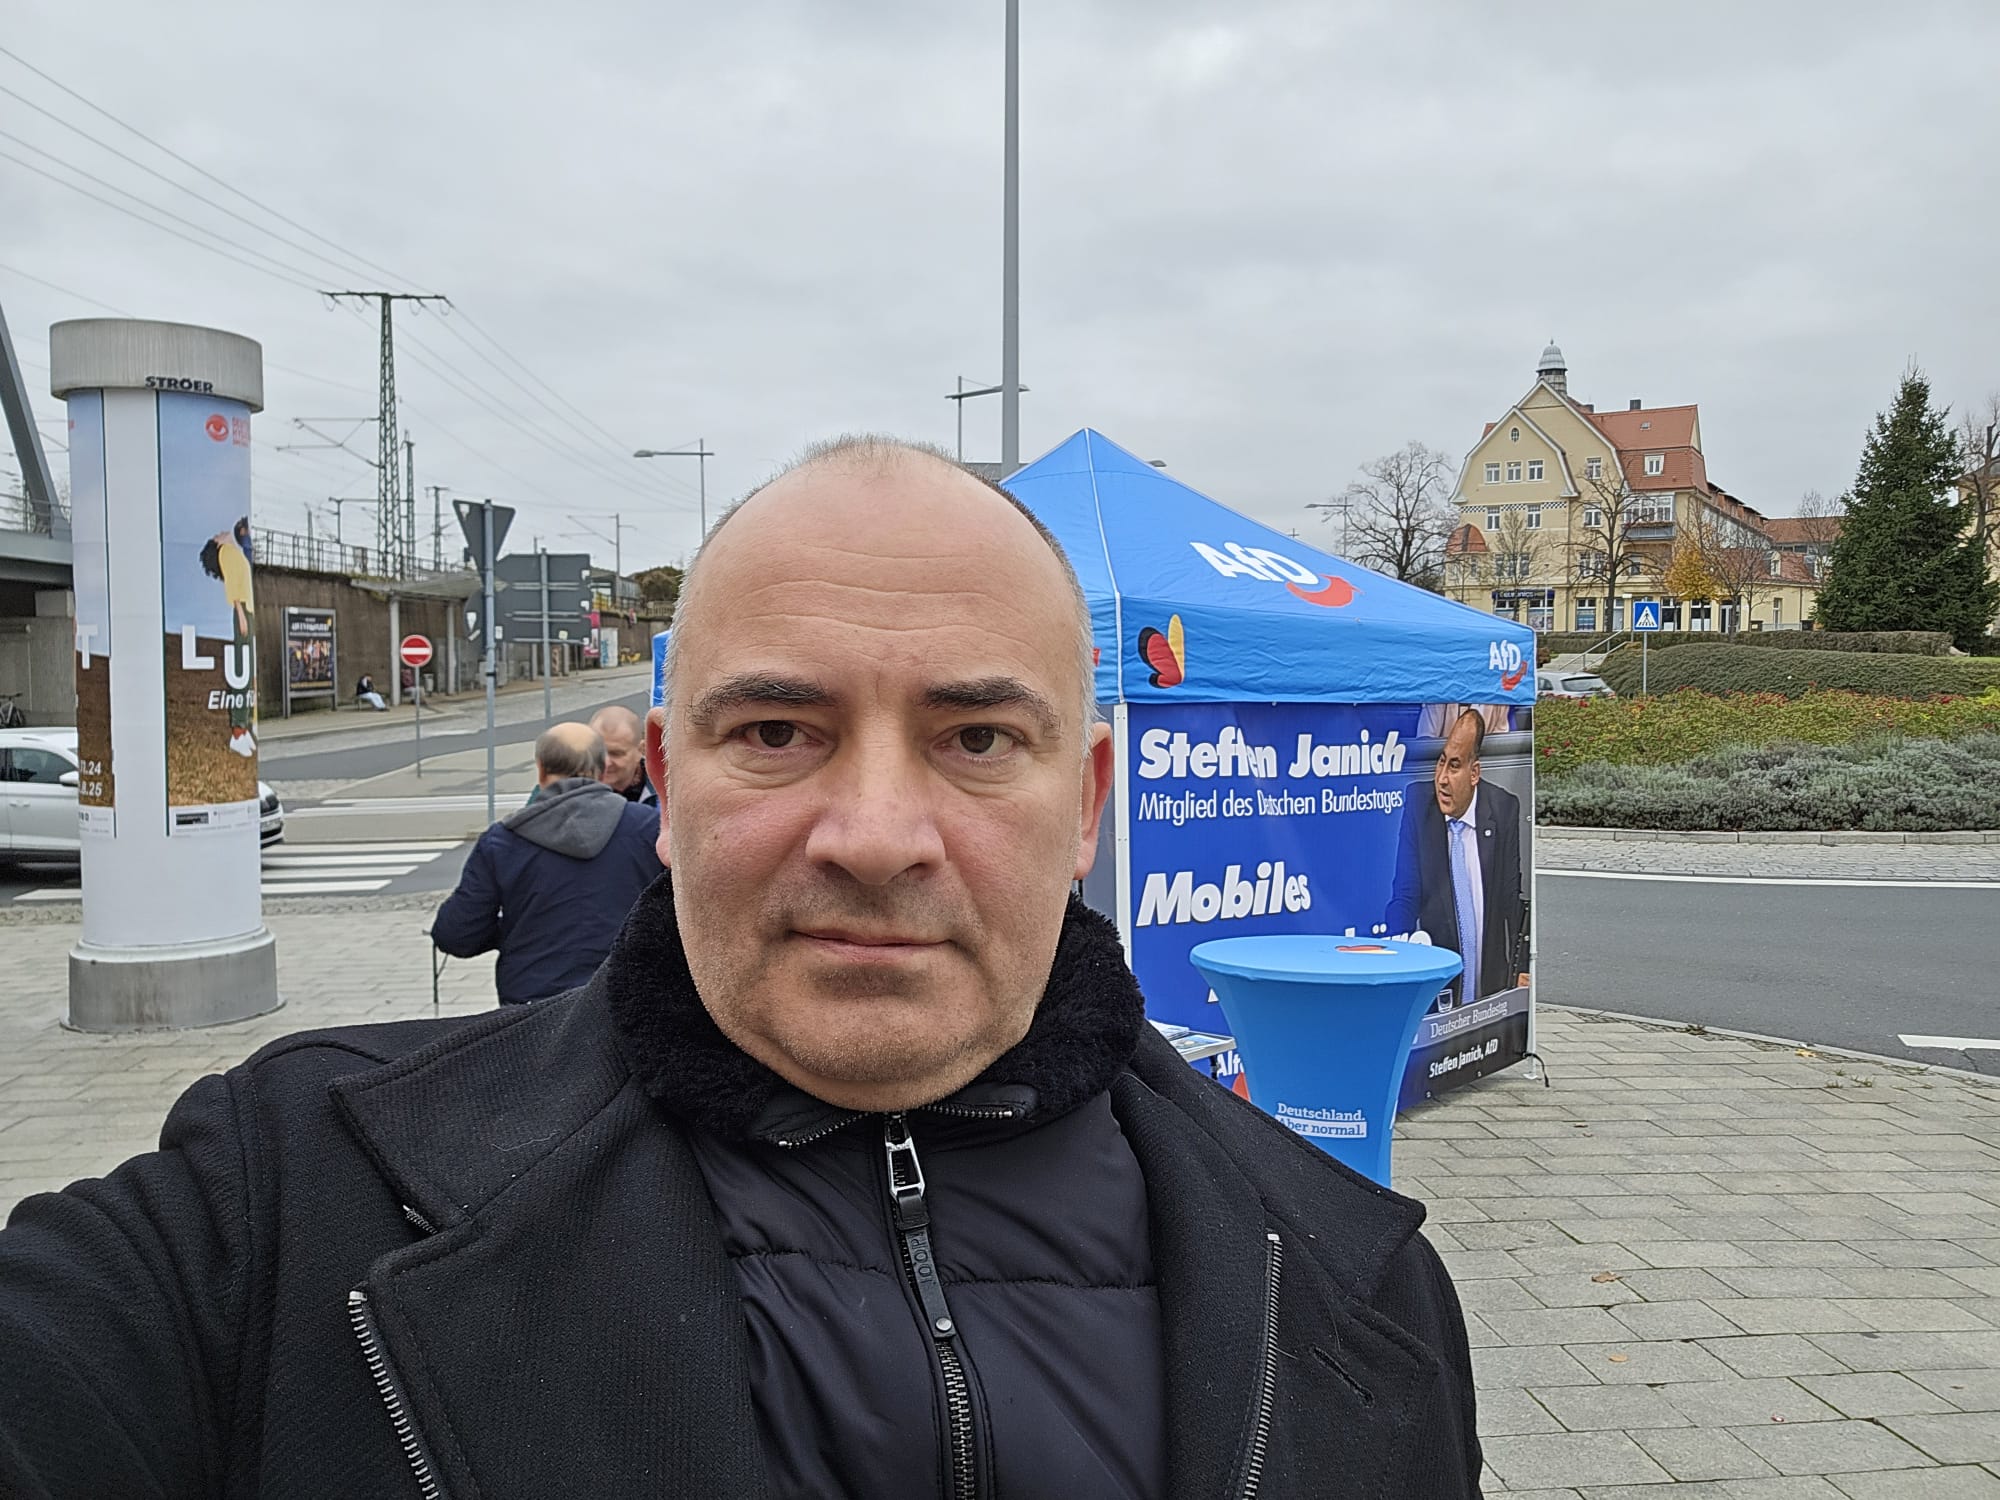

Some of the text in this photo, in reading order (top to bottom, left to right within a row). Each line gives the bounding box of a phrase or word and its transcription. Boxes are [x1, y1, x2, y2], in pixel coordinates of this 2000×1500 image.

[145, 376, 213, 393] STRÖER
[1189, 542, 1319, 585] AfD
[1489, 639, 1521, 671] AfD
[1288, 729, 1406, 777] Janich
[1138, 790, 1217, 826] Mitglied
[1222, 788, 1253, 817] des
[1322, 786, 1402, 814] Bundestages
[1136, 861, 1311, 927] Mobiles
[1430, 1015, 1471, 1039] Deutscher
[1216, 1050, 1245, 1077] Alt
[1428, 1038, 1499, 1078] Steffen Janich, AfD
[1278, 1103, 1365, 1121] Deutschland.
[1312, 1124, 1364, 1136] normal.
